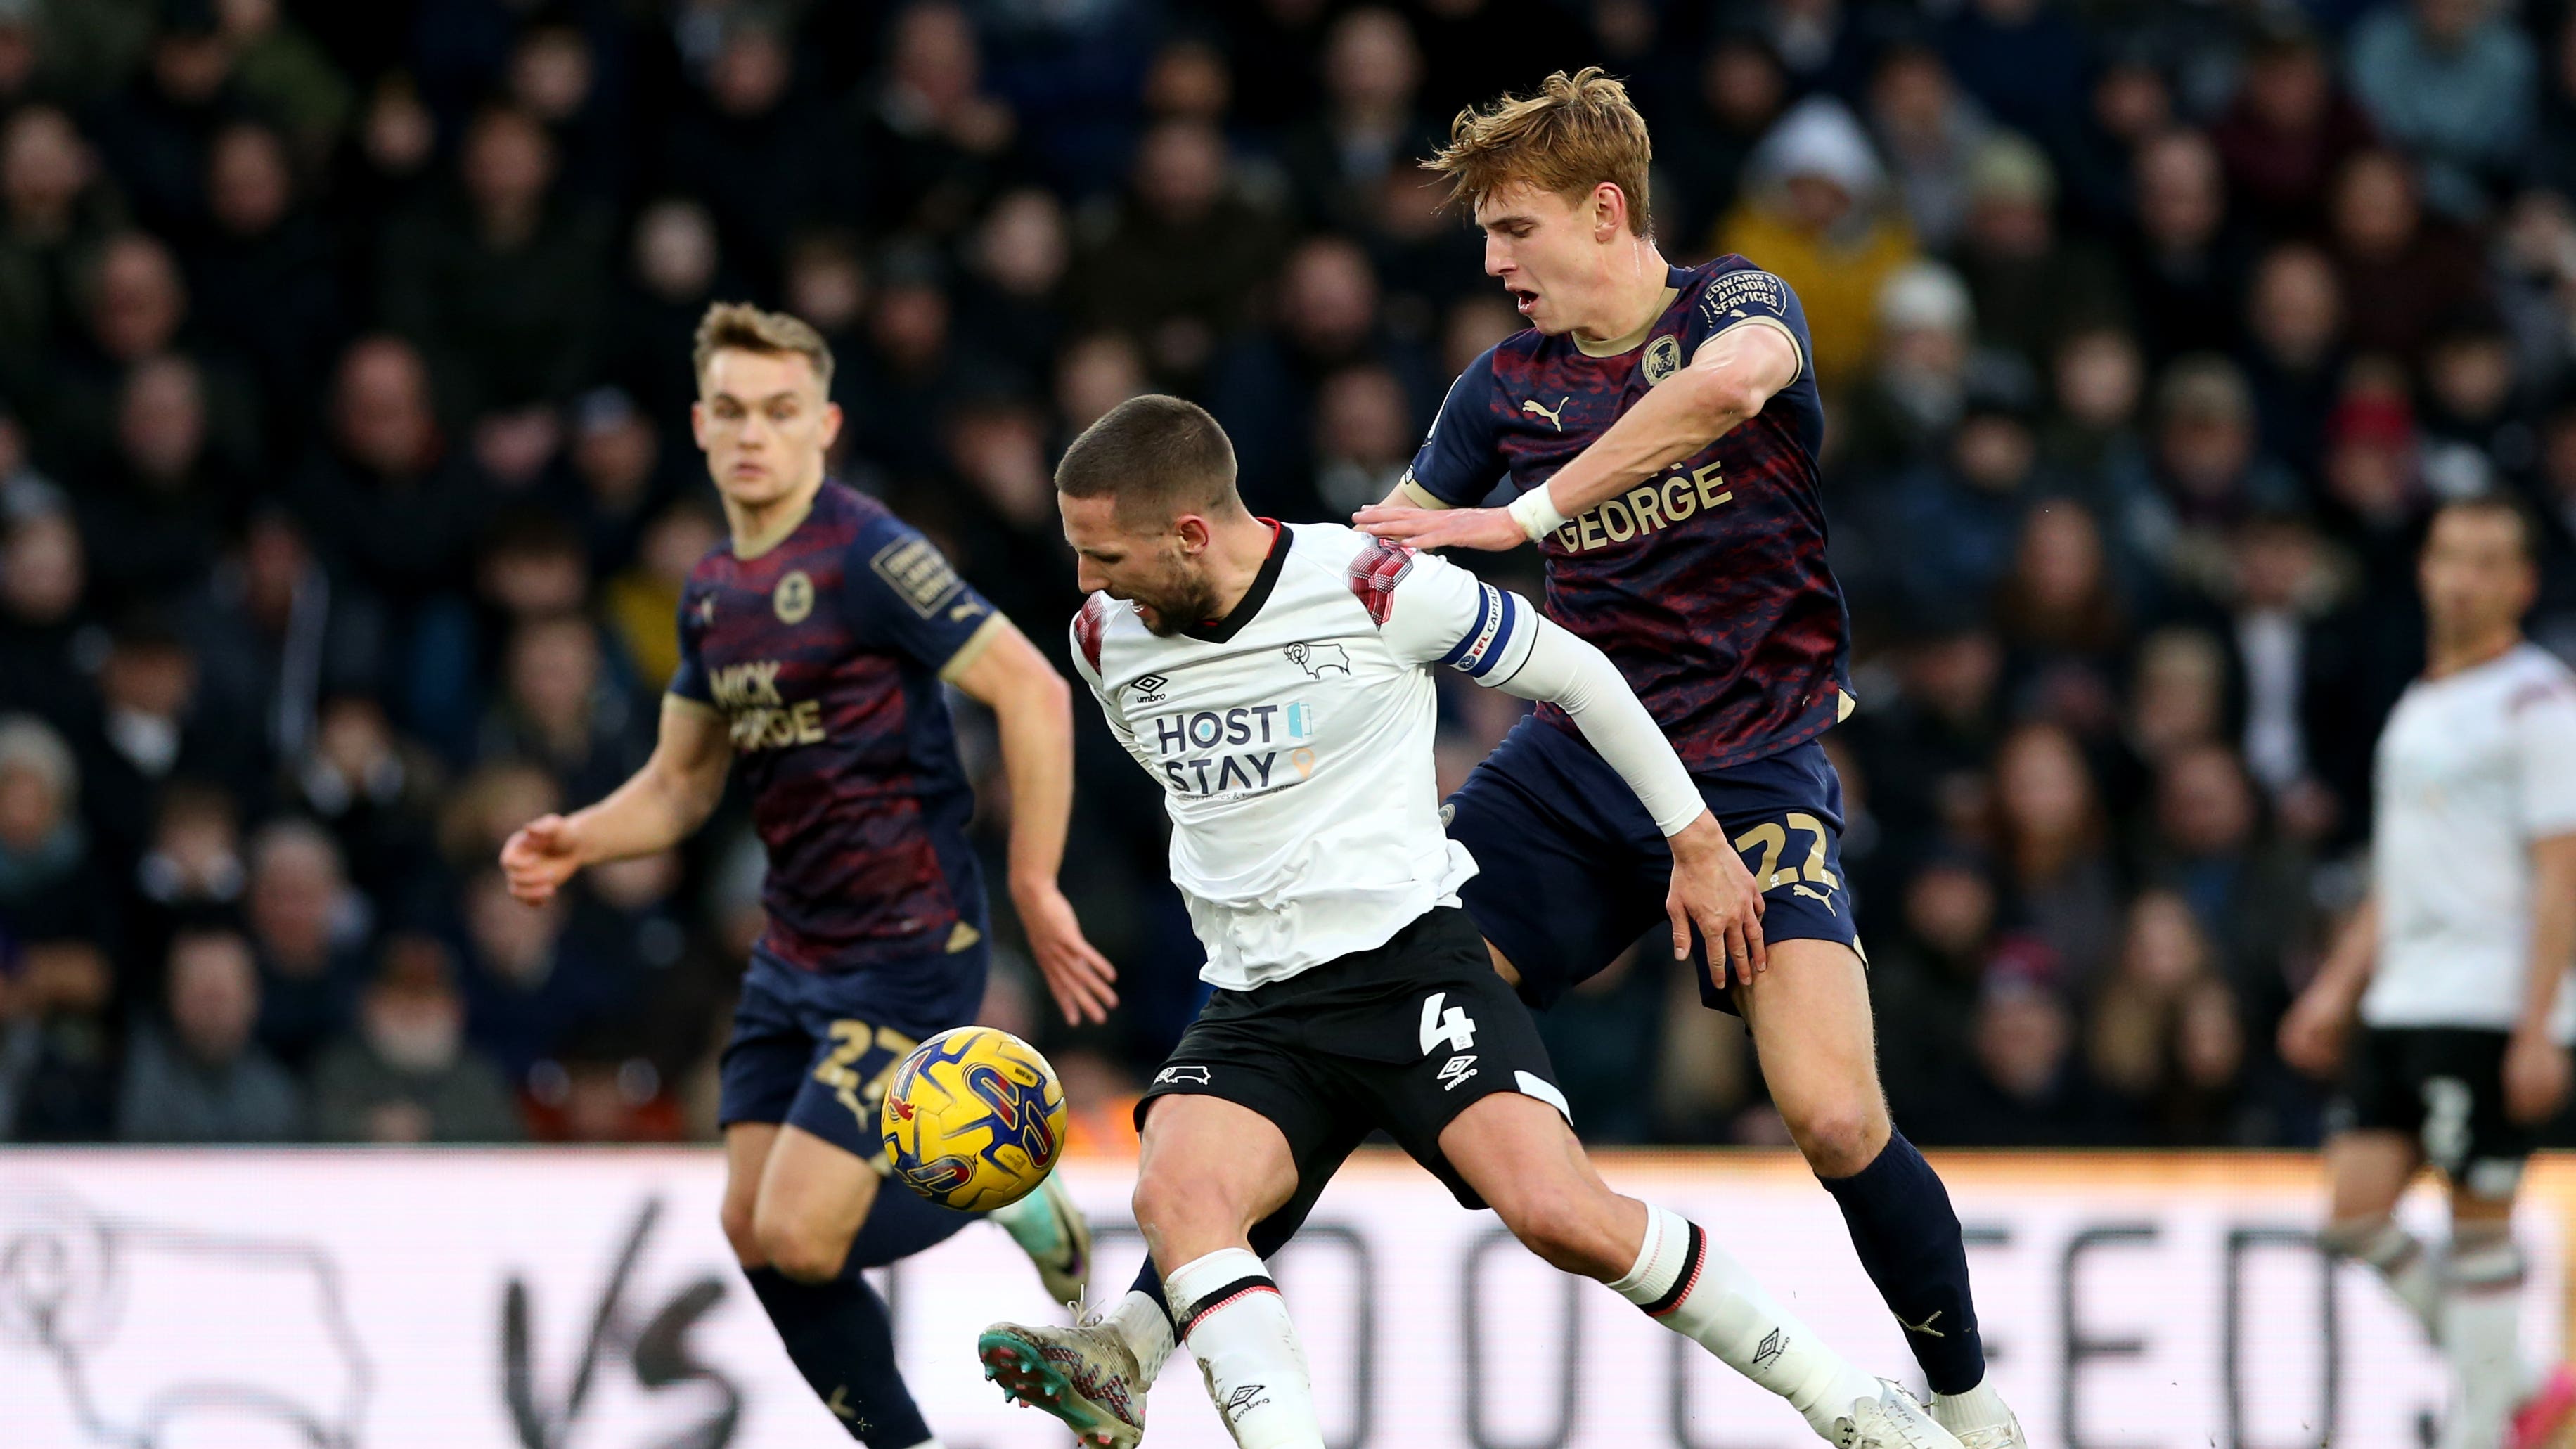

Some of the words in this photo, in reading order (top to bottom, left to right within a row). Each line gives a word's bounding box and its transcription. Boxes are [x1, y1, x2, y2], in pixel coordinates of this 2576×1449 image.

[1710, 281, 1777, 309] LAUNDRY
[1555, 461, 1733, 553] GEORGE
[1472, 636, 1490, 655] EFL
[1136, 693, 1166, 703] umbro
[1156, 705, 1278, 754] HOST
[1166, 752, 1277, 794] STAY
[1734, 813, 1840, 894] 22
[1419, 992, 1477, 1057] 4
[813, 1019, 920, 1100] 27
[1444, 1068, 1478, 1091] umbro
[1232, 1398, 1270, 1423] umbro
